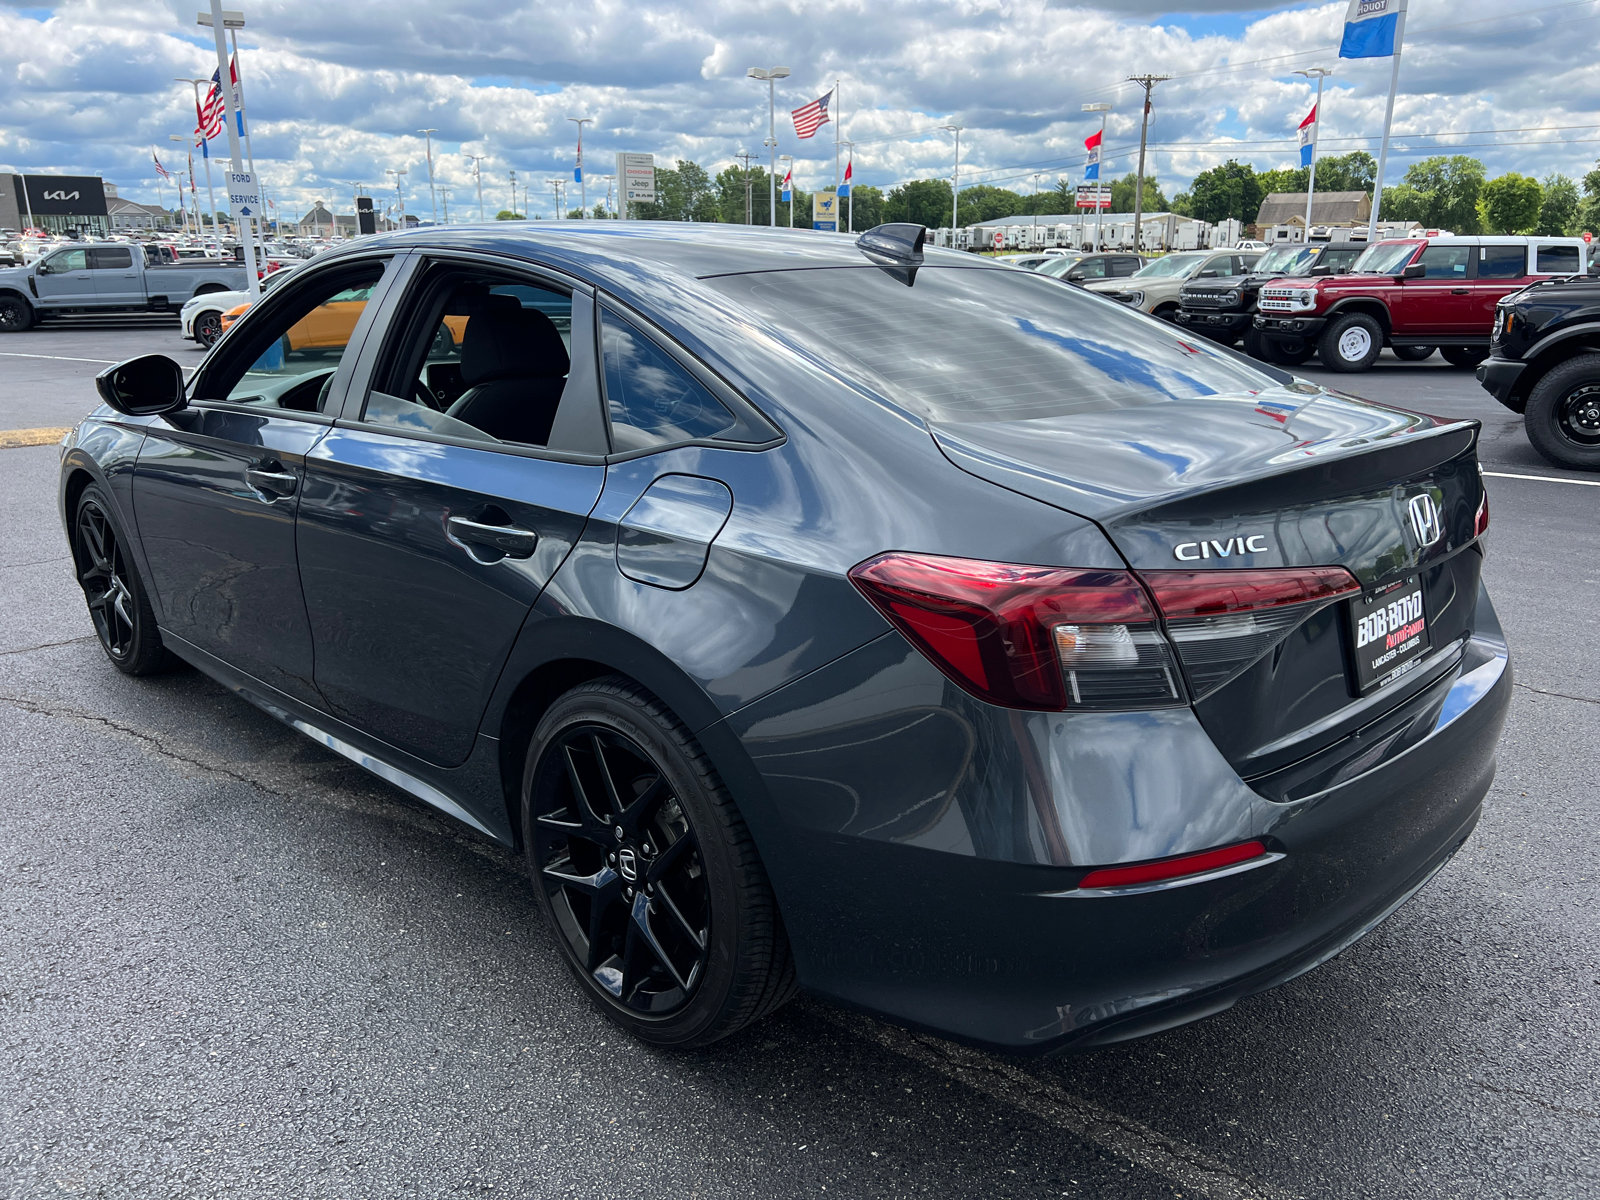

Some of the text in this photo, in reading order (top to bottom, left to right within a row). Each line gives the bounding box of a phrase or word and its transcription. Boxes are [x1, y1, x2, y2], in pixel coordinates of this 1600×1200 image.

[232, 174, 250, 182] FORD
[632, 180, 650, 188] Jeep
[44, 190, 80, 200] KIA
[230, 194, 258, 204] SERVICE
[1174, 534, 1268, 561] CIVIC
[1372, 649, 1397, 669] LANCASTER
[1399, 636, 1420, 654] COLUMBUS
